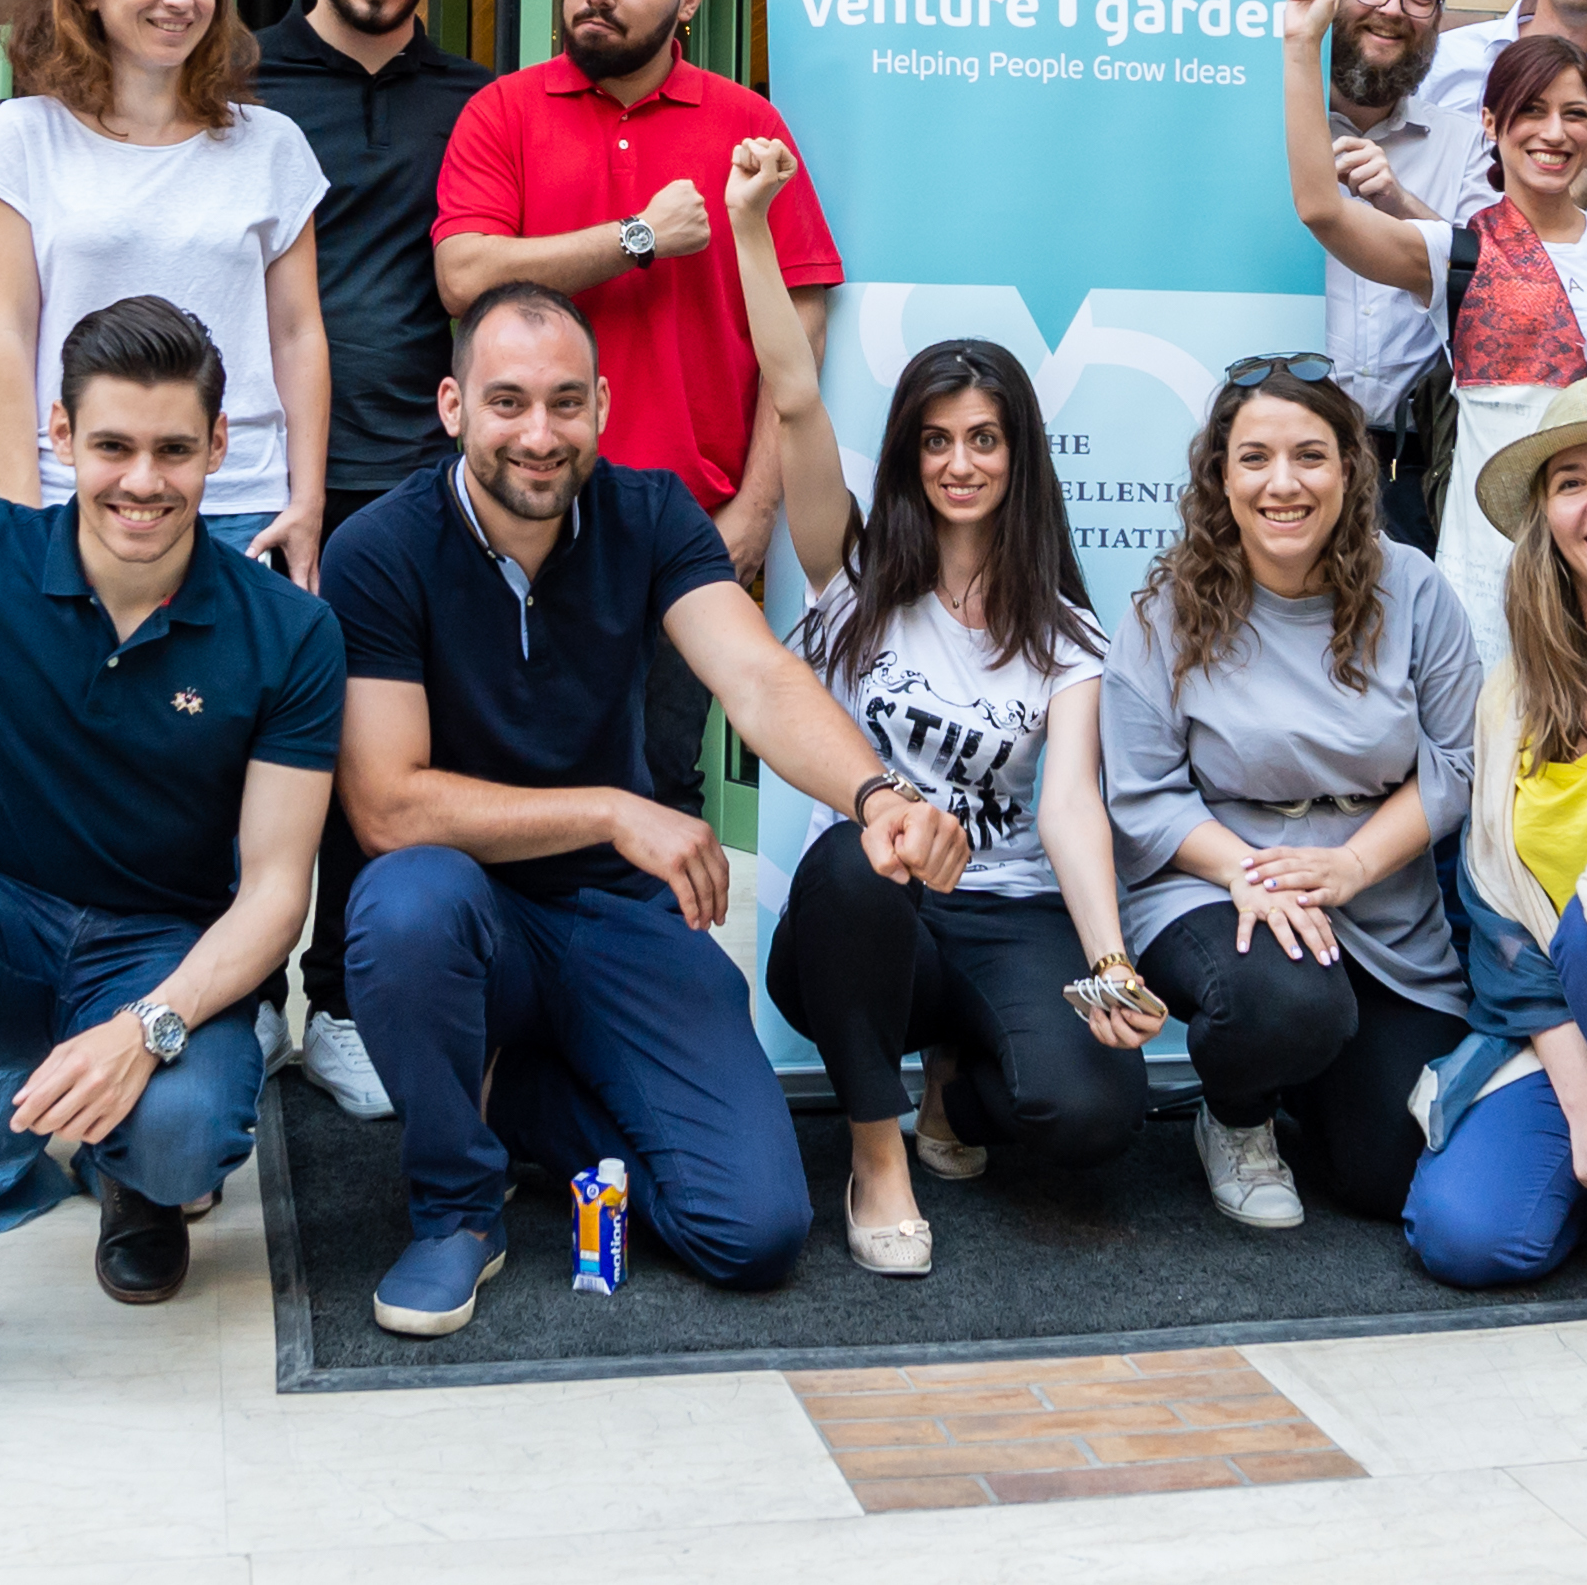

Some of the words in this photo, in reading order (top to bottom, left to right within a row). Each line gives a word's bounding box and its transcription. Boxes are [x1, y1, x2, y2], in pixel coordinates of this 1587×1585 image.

[872, 49, 980, 83] Helping
[989, 52, 1085, 84] People
[1093, 55, 1166, 83] Grow
[1175, 58, 1247, 86] Ideas
[1045, 433, 1091, 455] HE
[1060, 480, 1188, 503] ELLENI
[610, 1214, 623, 1283] motion
